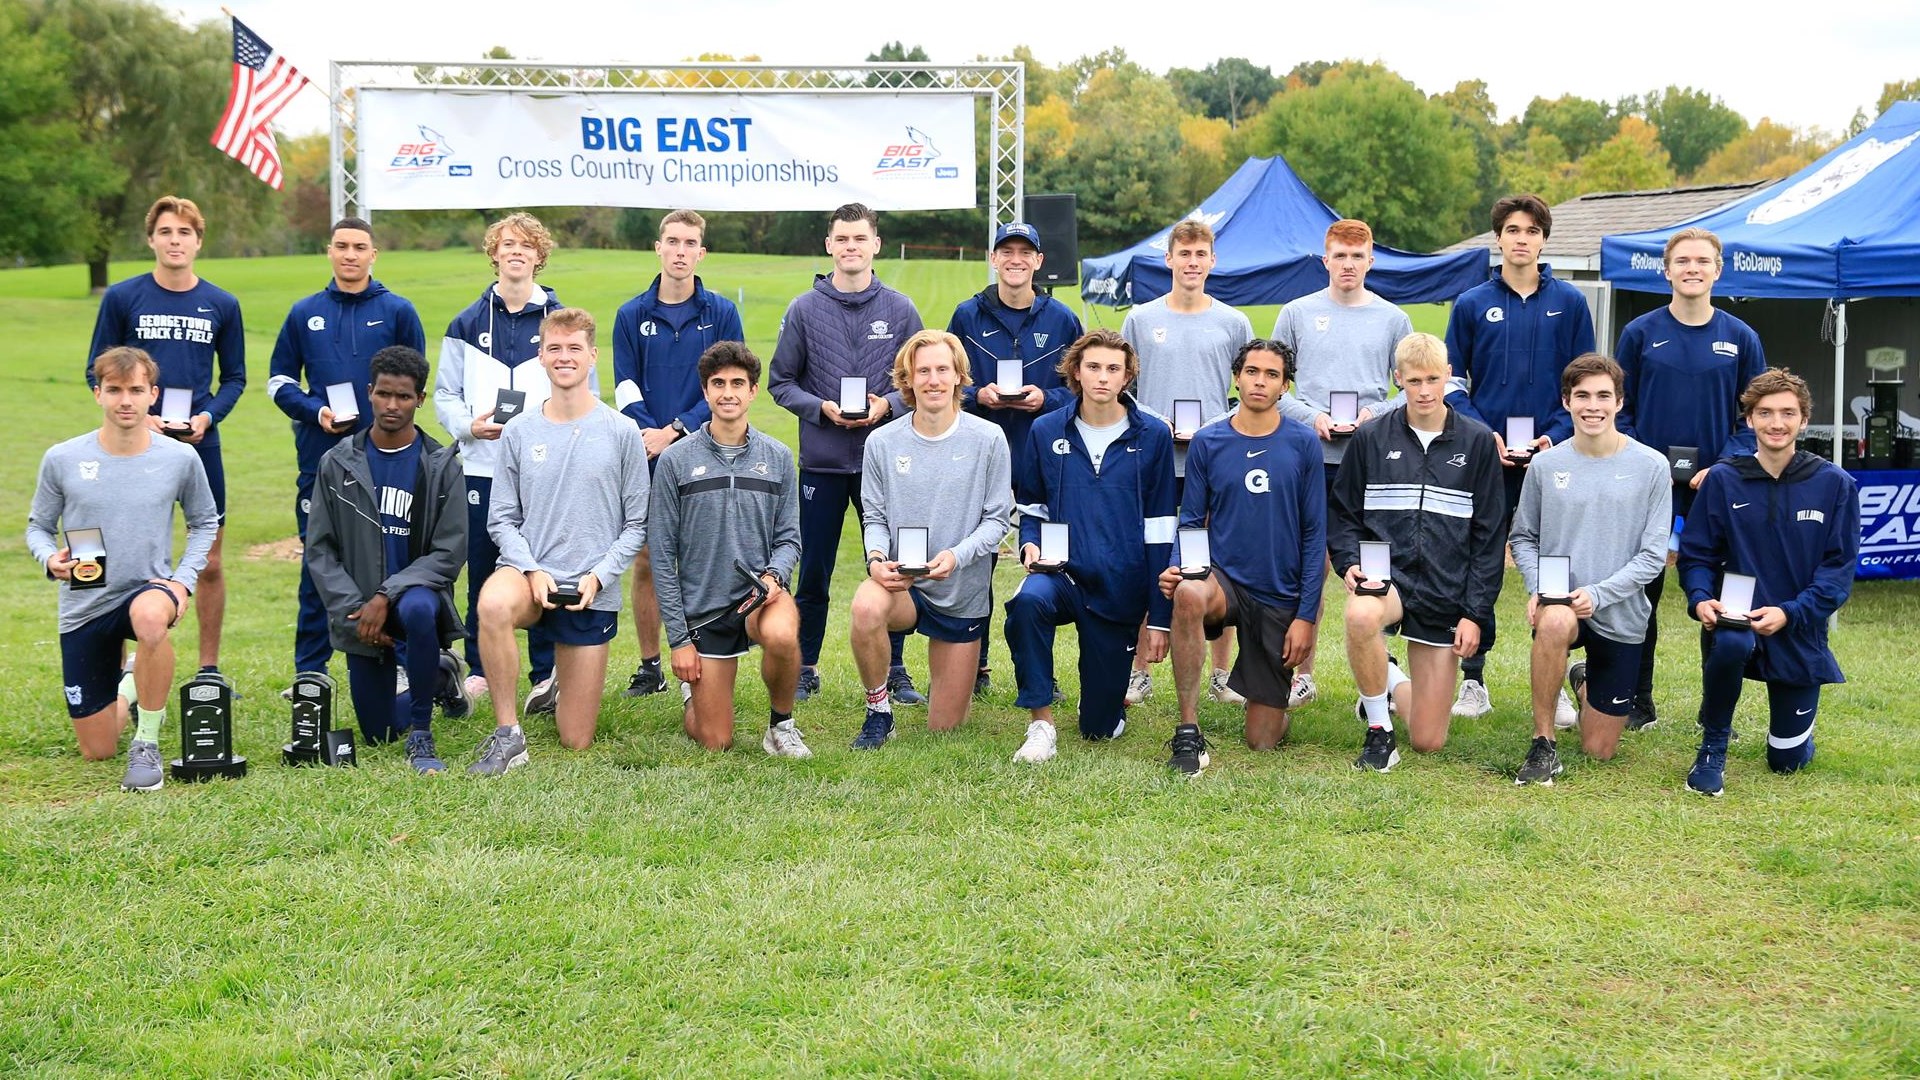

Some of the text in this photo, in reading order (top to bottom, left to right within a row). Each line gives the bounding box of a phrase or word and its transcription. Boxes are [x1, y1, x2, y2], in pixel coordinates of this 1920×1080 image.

[581, 116, 752, 152] BIG EAST
[397, 143, 437, 155] BIG
[883, 145, 924, 156] BIG
[390, 156, 447, 166] EAST
[877, 158, 935, 168] EAST
[498, 154, 839, 187] Cross Country Championships
[1733, 251, 1782, 277] #GoDawgs
[1485, 306, 1504, 322] G
[139, 315, 211, 331] GEORGETOWN
[307, 315, 326, 331] G
[640, 321, 658, 336] G
[135, 327, 171, 339] TRACK
[173, 328, 182, 340] &
[1033, 333, 1048, 348] V
[1052, 438, 1071, 454] G
[1245, 469, 1271, 494] G
[468, 490, 480, 505] G
[803, 485, 816, 500] V
